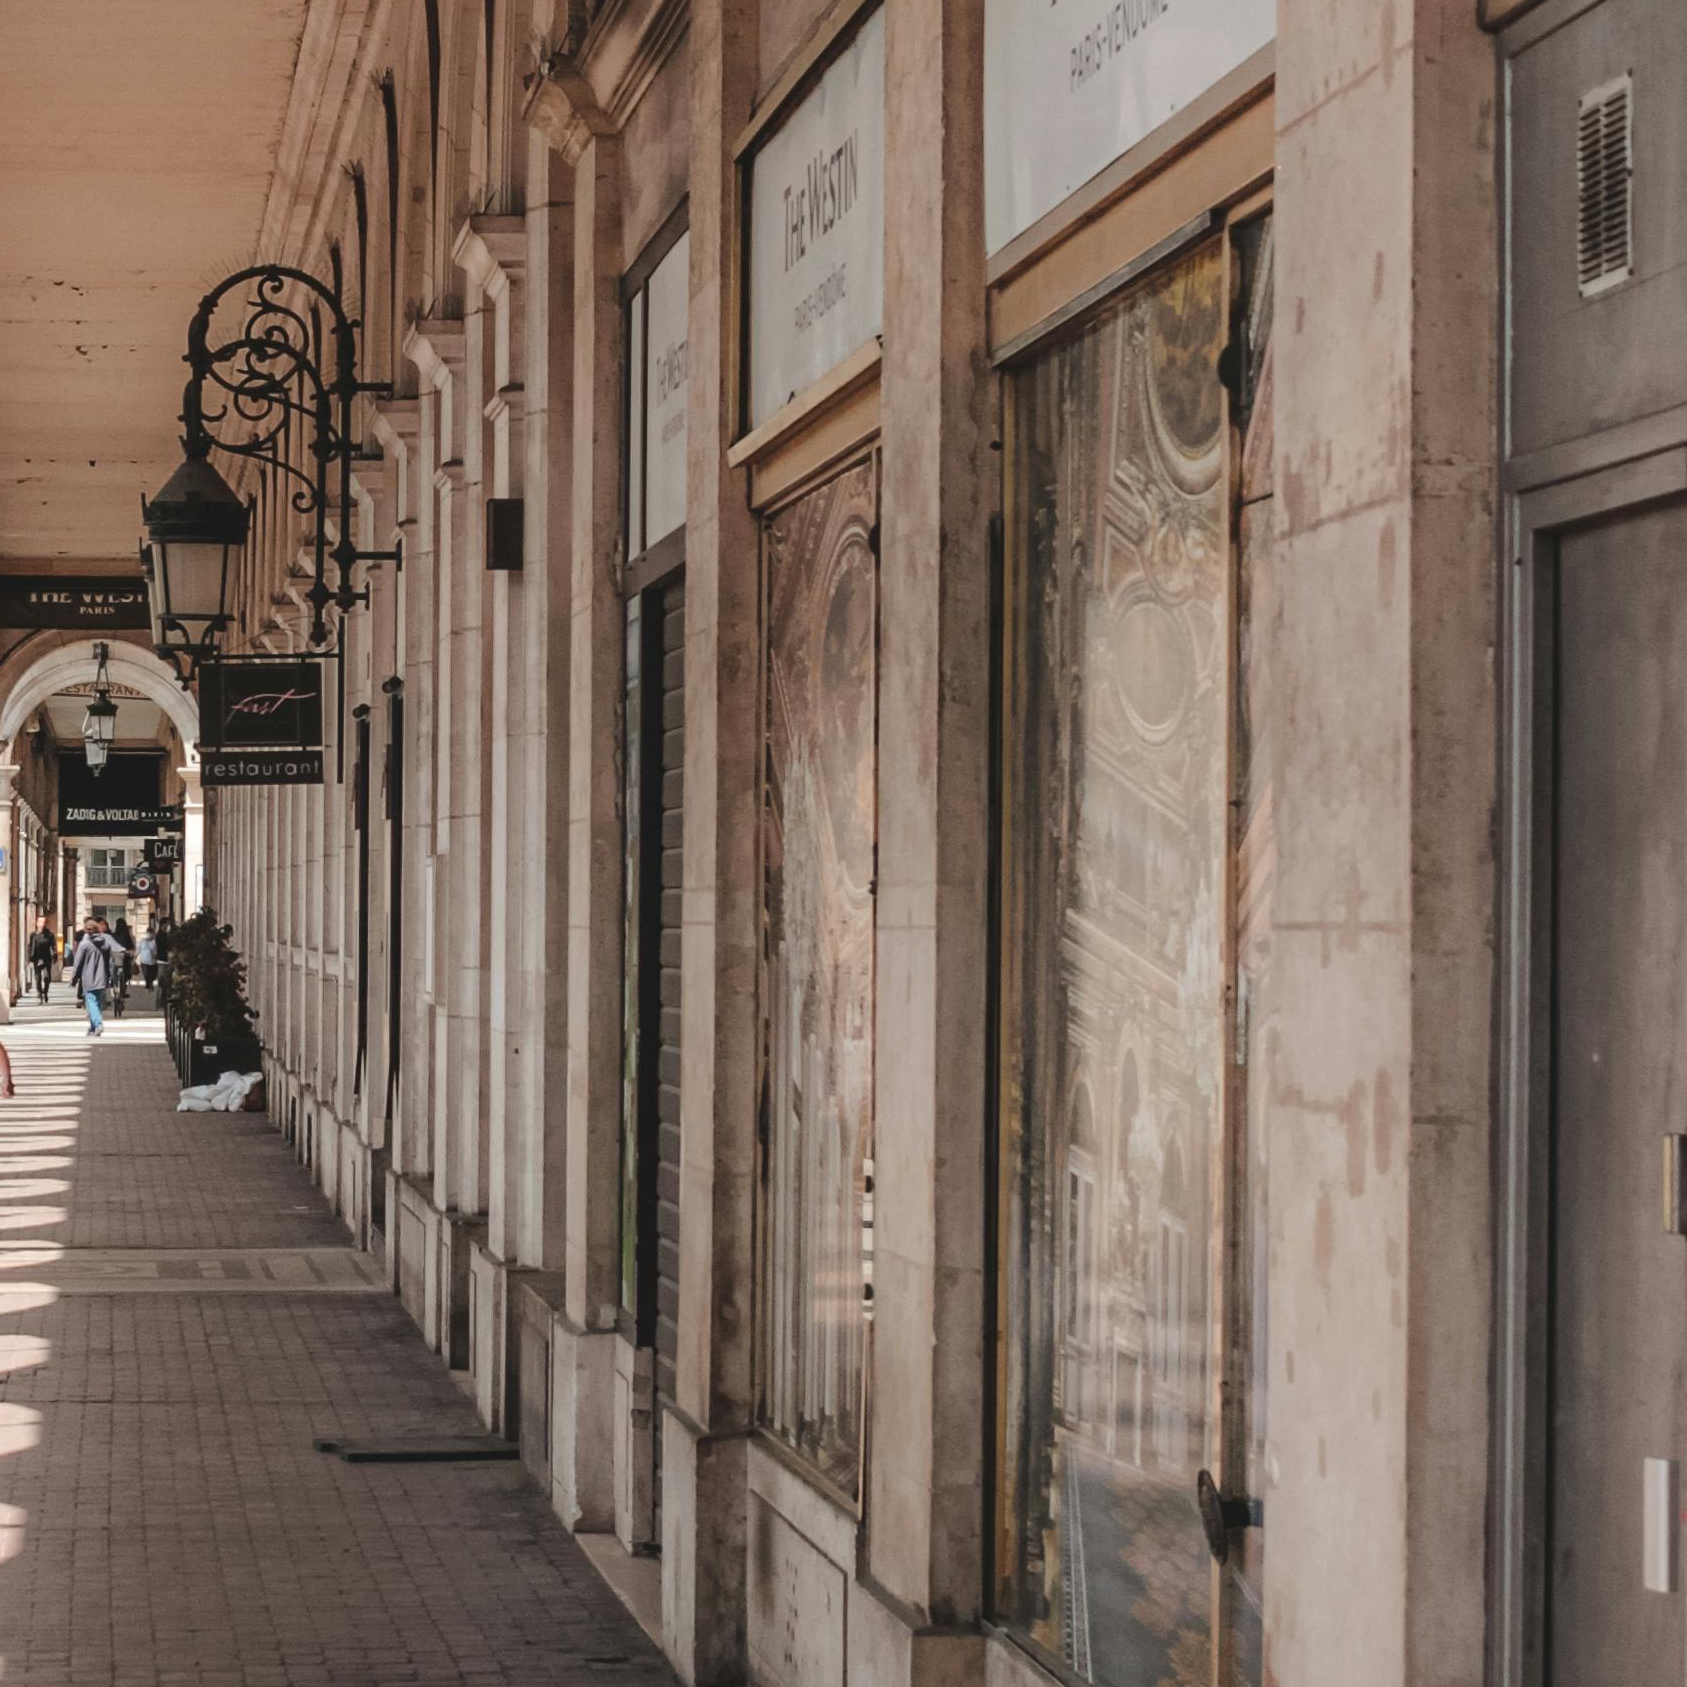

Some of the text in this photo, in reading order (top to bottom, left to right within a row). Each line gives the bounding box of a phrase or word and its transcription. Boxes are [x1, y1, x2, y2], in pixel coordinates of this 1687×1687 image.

[784, 129, 858, 272] THE WESTIN
[79, 606, 115, 615] PARIS
[205, 760, 319, 777] restaurant
